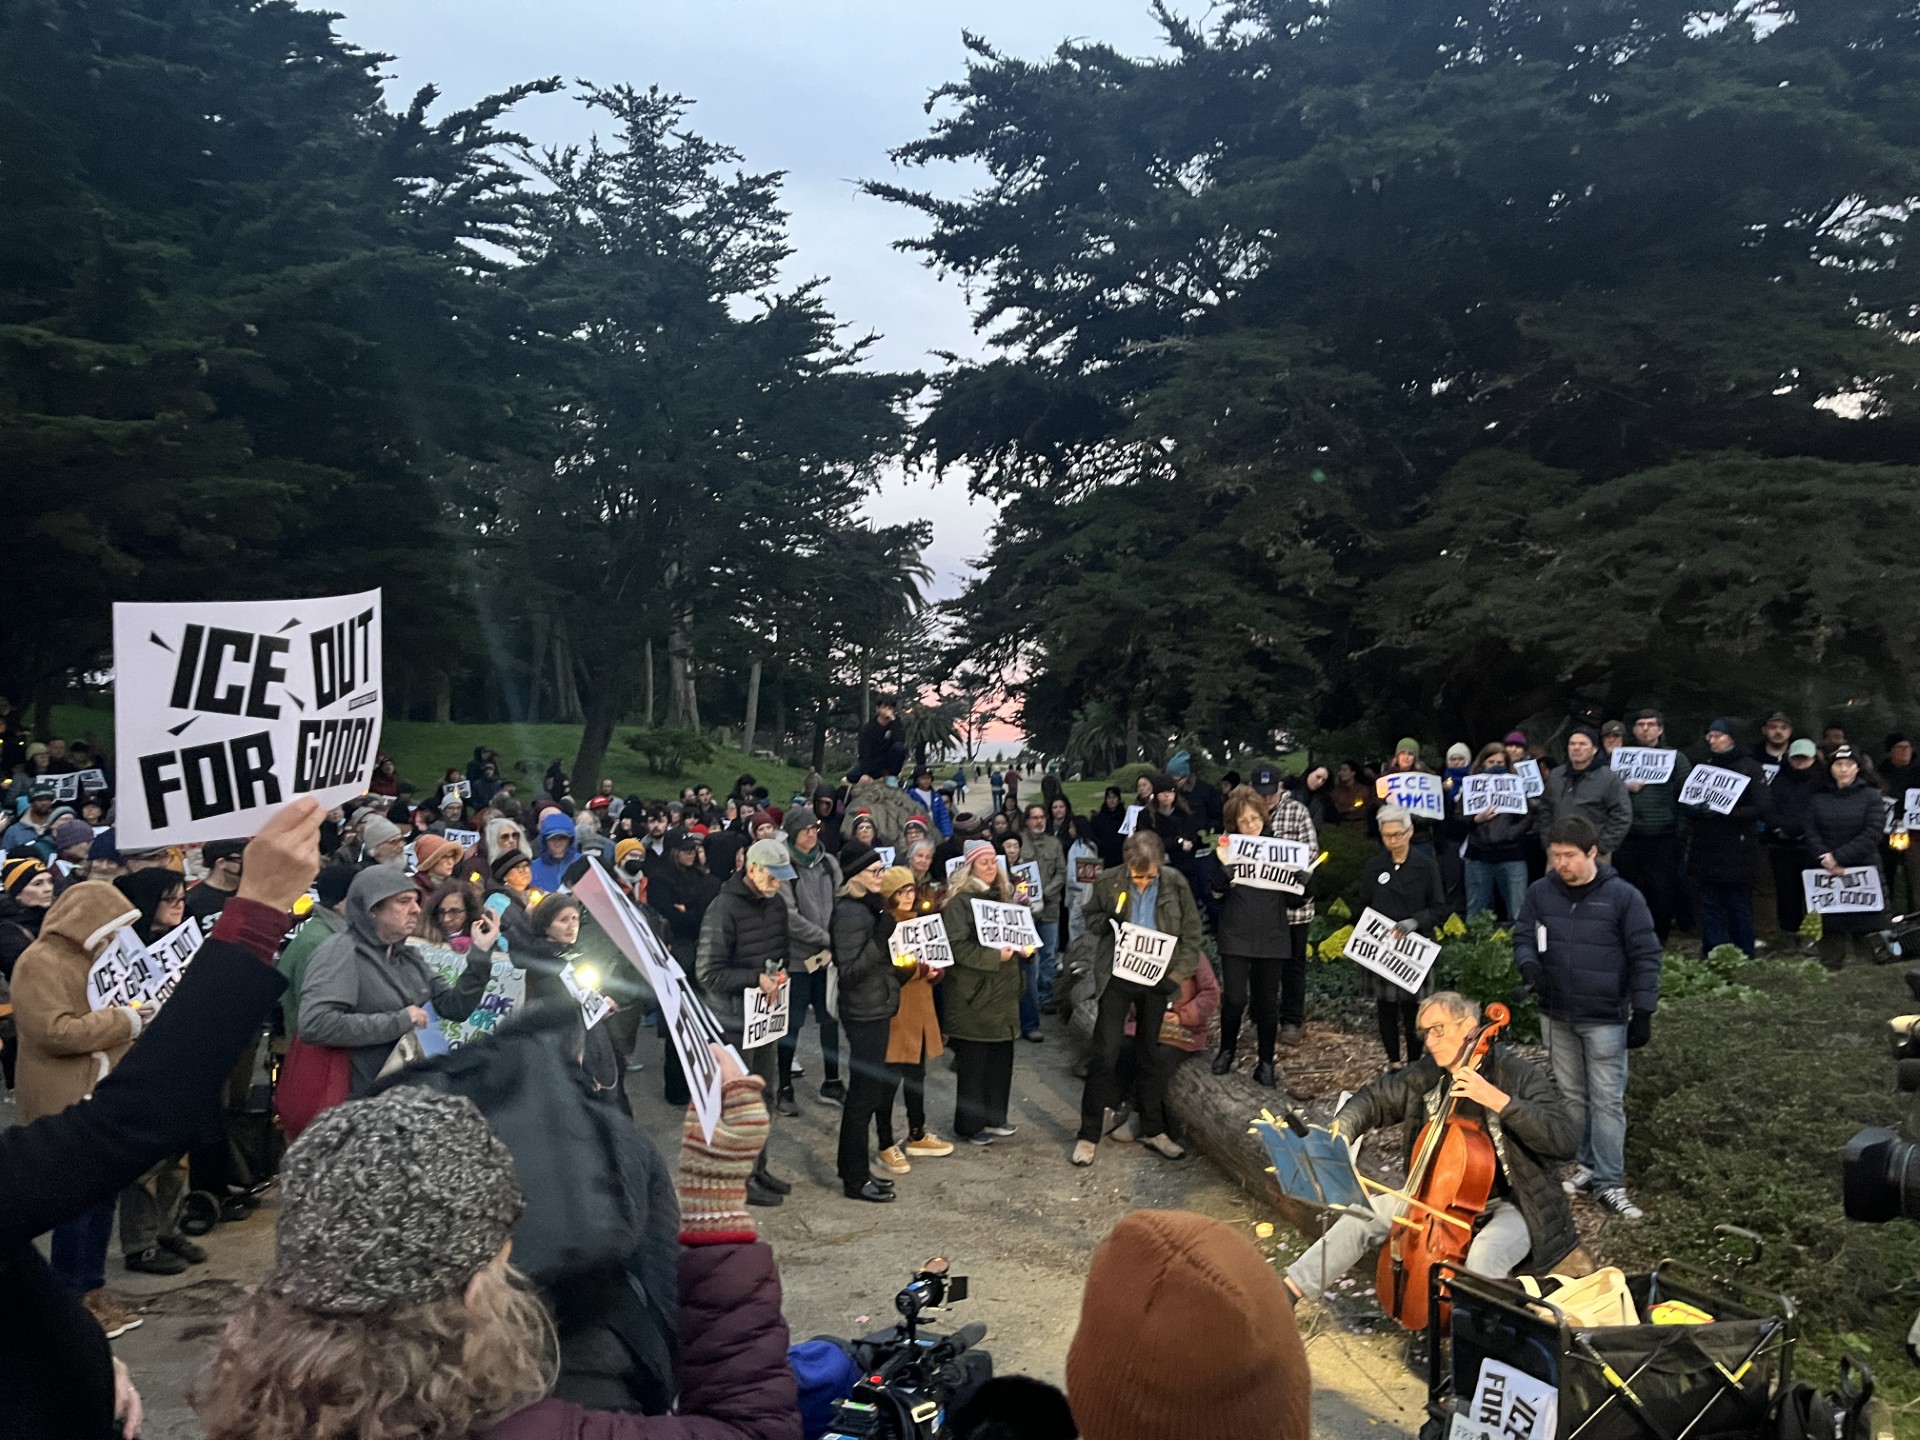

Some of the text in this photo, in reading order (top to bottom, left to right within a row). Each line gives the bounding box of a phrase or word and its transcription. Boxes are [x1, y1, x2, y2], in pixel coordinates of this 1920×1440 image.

[170, 606, 374, 720] ICE OUT
[1619, 752, 1669, 767] ICE OUT
[138, 716, 375, 830] FOR GOOD!
[1387, 776, 1431, 791] ICE
[1634, 766, 1668, 781] GOOD!
[1693, 768, 1742, 791] ICE OUT
[1471, 778, 1488, 793] ICE
[1494, 778, 1517, 792] OUT
[1467, 792, 1523, 812] FOR GOOD!
[1683, 786, 1734, 810] FOR GOOD!
[1237, 839, 1301, 863] ICE OUT
[1237, 863, 1257, 880] OR
[1814, 870, 1868, 889] ICE OUT
[1811, 891, 1836, 908] FOR
[982, 903, 1025, 927] ICE OUT
[902, 918, 942, 944] ICE OUT
[981, 926, 1036, 946] FOR GOOD!
[1365, 918, 1431, 961] ICE OUT
[171, 926, 198, 962] OUT
[1135, 935, 1167, 956] OUT
[1122, 952, 1162, 982] GOOD!
[1351, 938, 1421, 987] FOR GOOD!
[93, 961, 118, 997] ICE
[748, 1018, 768, 1044] FOR
[1479, 1371, 1506, 1428] FOR
